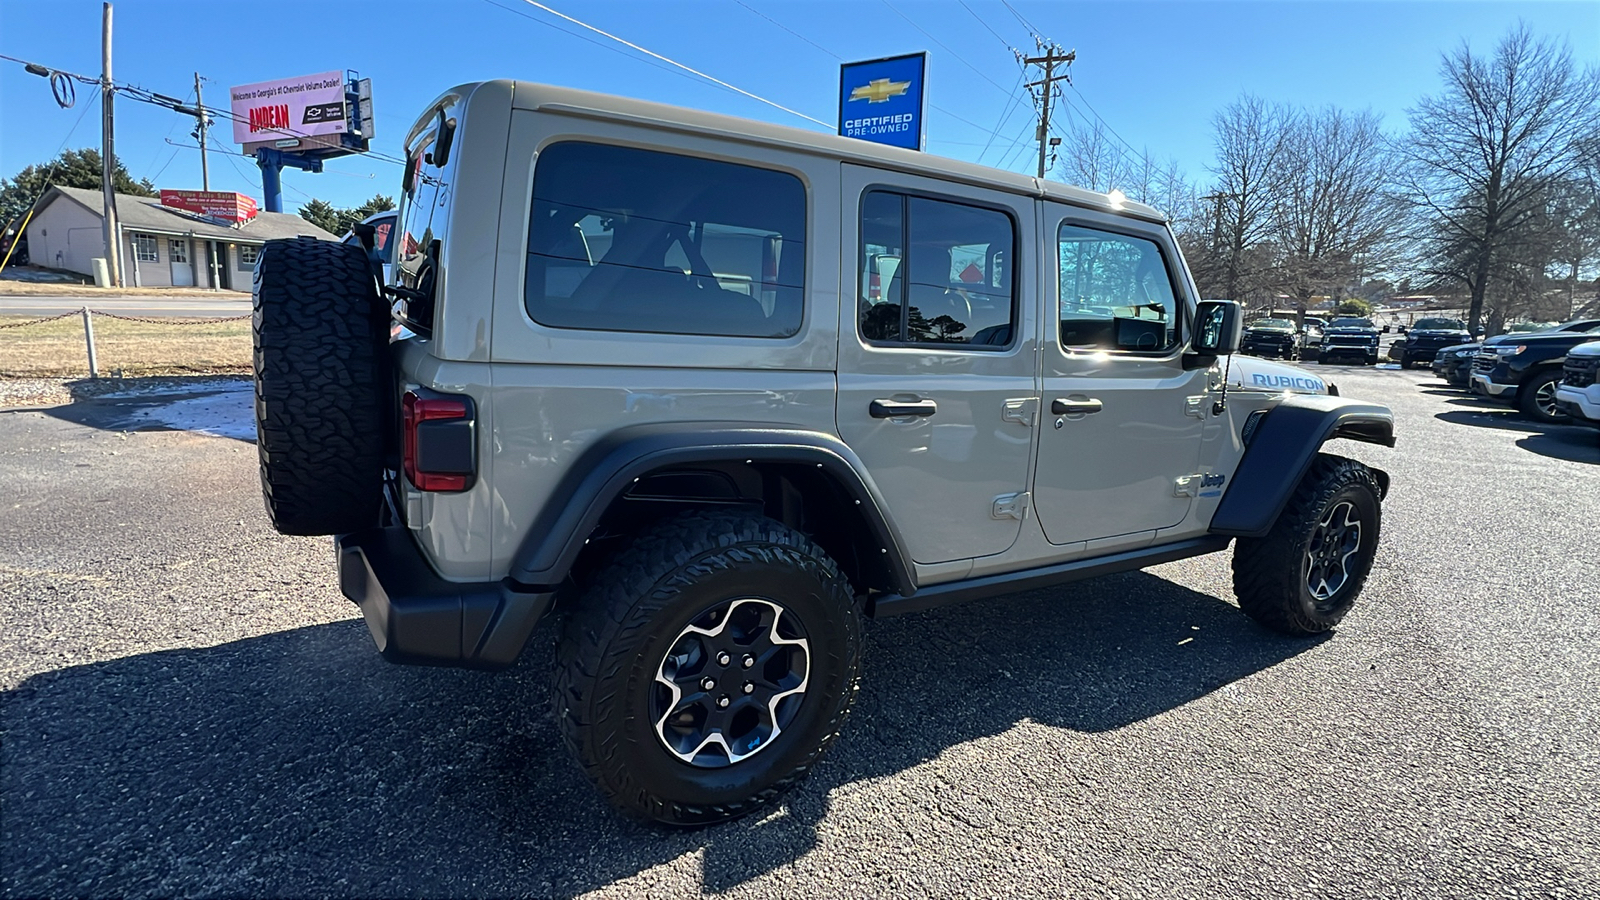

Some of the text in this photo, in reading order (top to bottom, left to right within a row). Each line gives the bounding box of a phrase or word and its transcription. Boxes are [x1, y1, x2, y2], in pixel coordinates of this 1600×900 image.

[233, 92, 251, 101] Welcome
[257, 87, 277, 98] Georgia's
[283, 83, 304, 94] Chevrolet
[305, 82, 322, 91] Volume
[249, 104, 290, 133] ANDEAN
[845, 113, 913, 129] CERTIFIED
[847, 123, 909, 137] PRE-OWNED
[1252, 373, 1325, 391] RUBICON
[1200, 472, 1225, 488] Jeep
